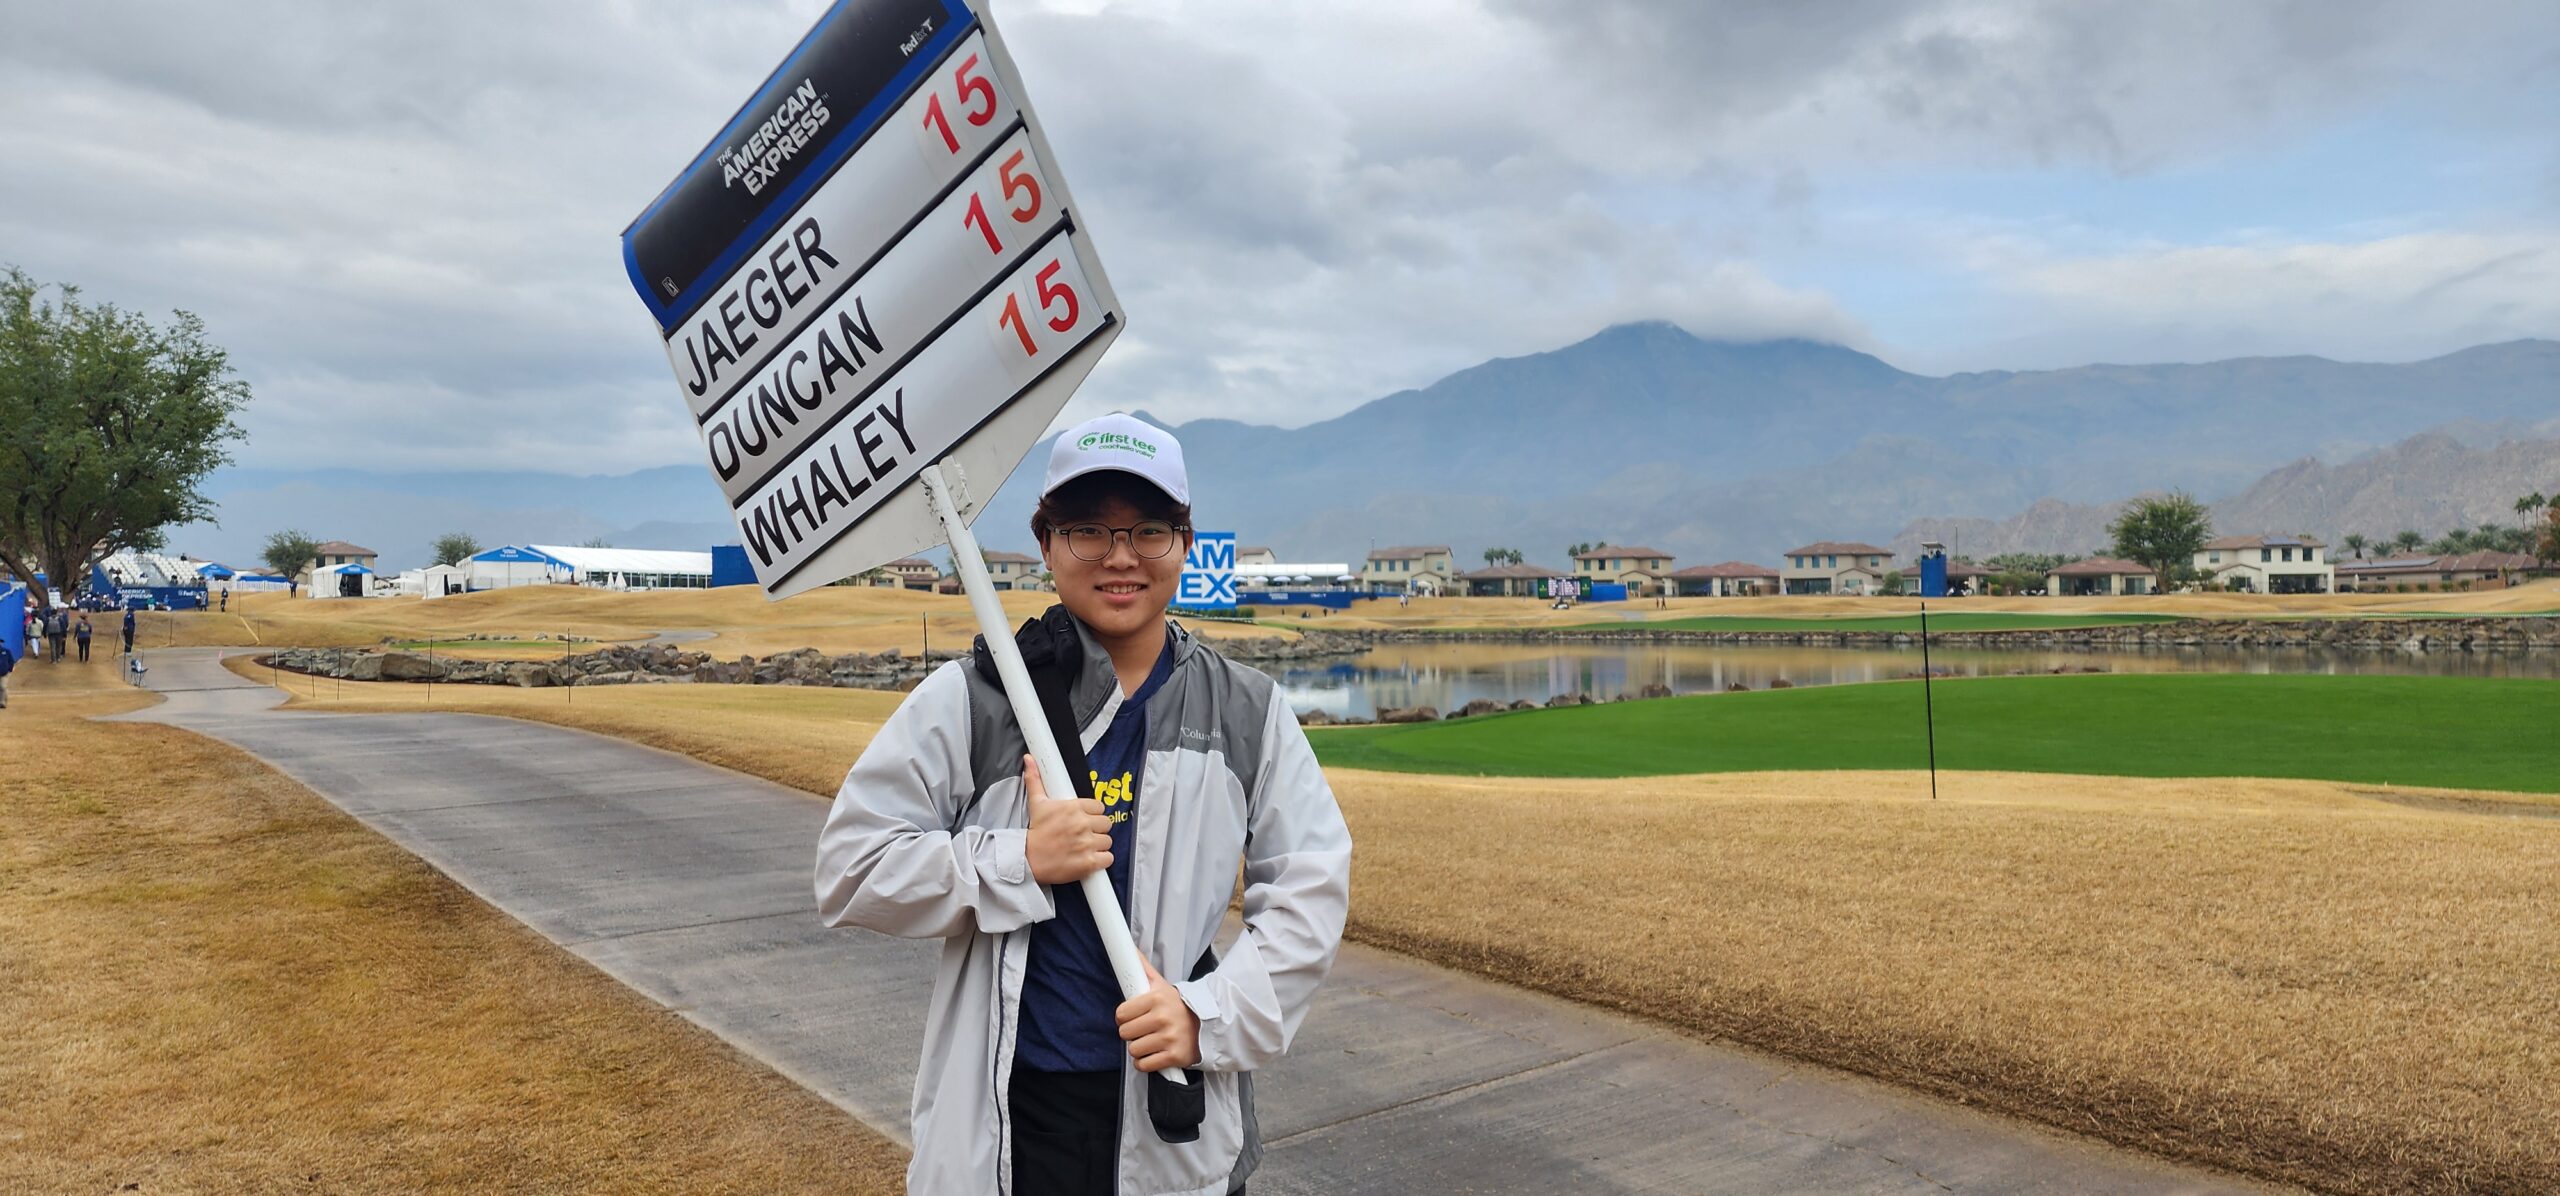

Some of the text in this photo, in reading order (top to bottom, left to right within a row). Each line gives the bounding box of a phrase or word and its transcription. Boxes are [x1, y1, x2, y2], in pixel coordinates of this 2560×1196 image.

[717, 145, 733, 167] THE
[723, 78, 817, 189] AMERICAN
[742, 98, 830, 196] EXPRESS
[686, 53, 997, 397] JAEGER 15
[708, 150, 1042, 484] DUNCAN 15
[740, 258, 1079, 569] WHALEY 15
[1099, 432, 1130, 444] first
[1132, 437, 1157, 453] tee
[1180, 572, 1234, 599] EX
[1185, 543, 1235, 569] AM
